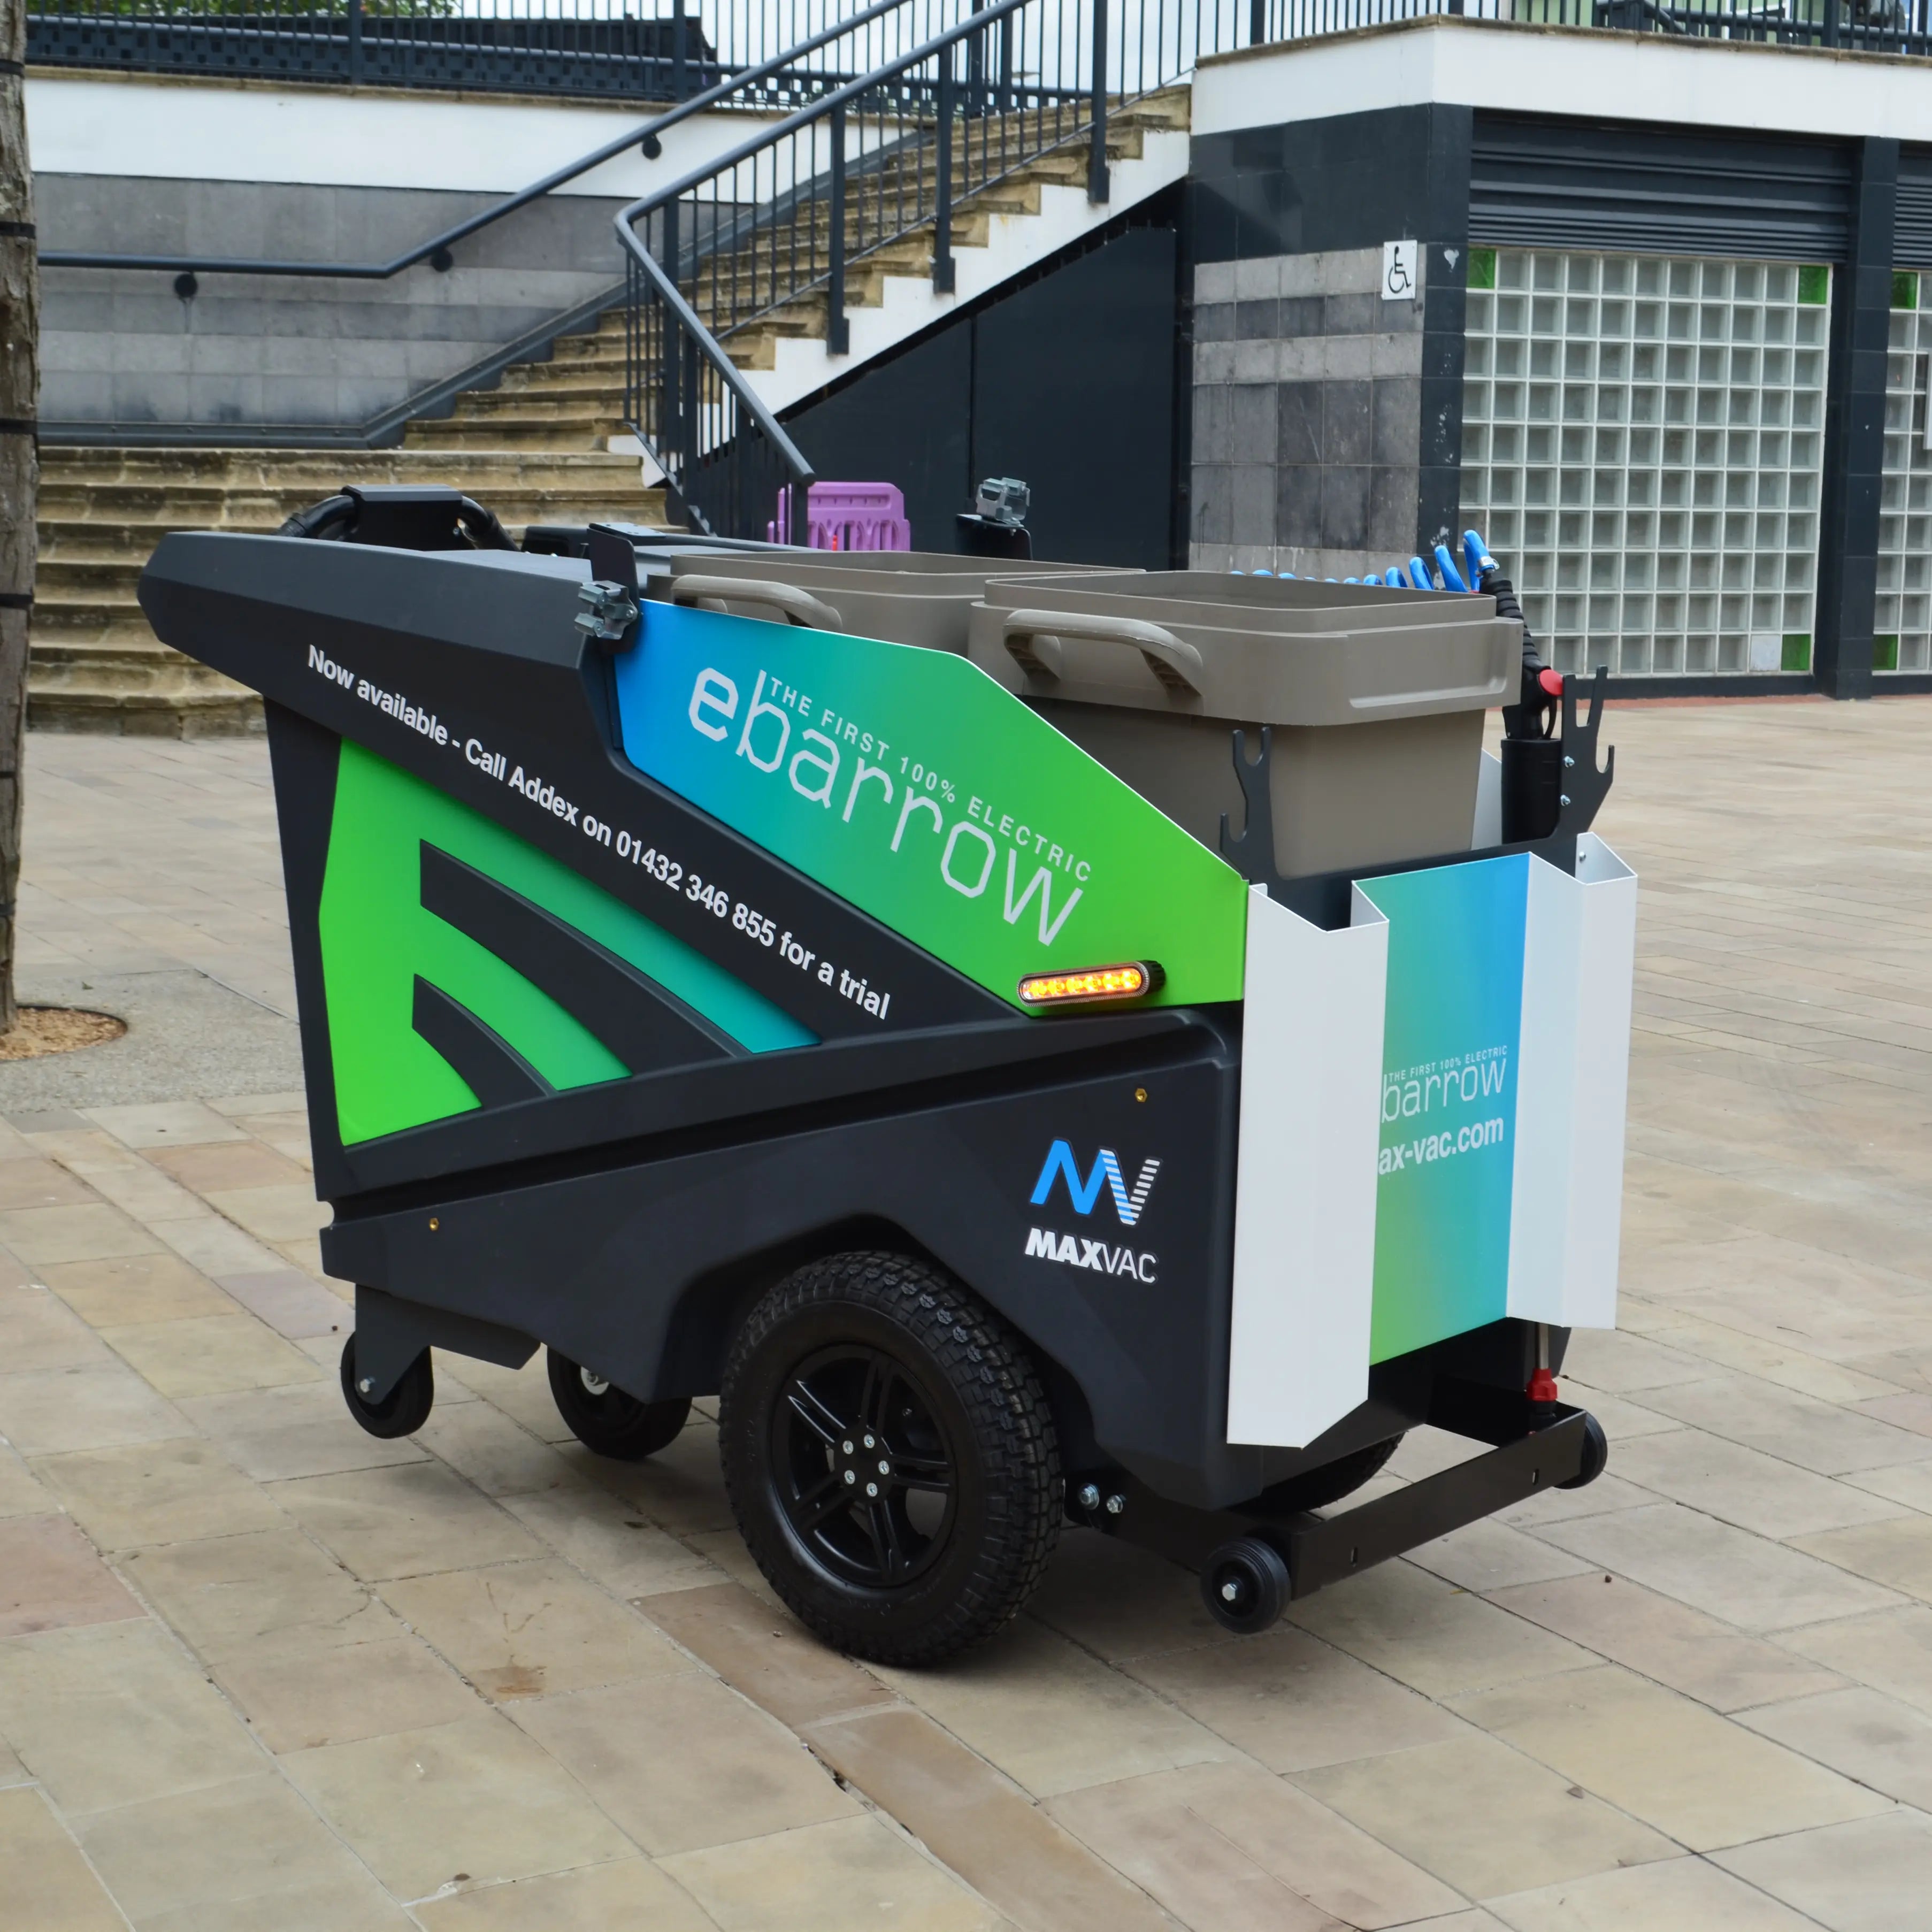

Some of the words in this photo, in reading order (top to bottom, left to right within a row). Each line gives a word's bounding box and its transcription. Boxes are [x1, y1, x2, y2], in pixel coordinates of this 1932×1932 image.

[688, 668, 1084, 947] ebarrow
[771, 677, 812, 716] THE
[821, 709, 890, 761] FIRST
[901, 757, 956, 803] 100%
[967, 795, 1091, 881] ELECTRIC
[308, 645, 355, 689] Now
[357, 679, 448, 745] available
[465, 738, 507, 781] Call
[508, 765, 579, 826] Addex
[582, 815, 611, 847] on
[616, 831, 683, 891] 01432
[686, 874, 729, 918] 346
[732, 903, 777, 947] 855
[779, 931, 816, 971] for
[817, 962, 834, 986] a
[839, 969, 891, 1020] trial
[1382, 1058, 1506, 1123] barrow
[1389, 1070, 1406, 1083] THE
[1410, 1062, 1437, 1078] FIRST
[1440, 1057, 1461, 1070] 100%
[1465, 1045, 1508, 1064] ELECTRIC
[1378, 1117, 1504, 1175] ax-vac.com
[1024, 1228, 1157, 1283] MAXVAC
